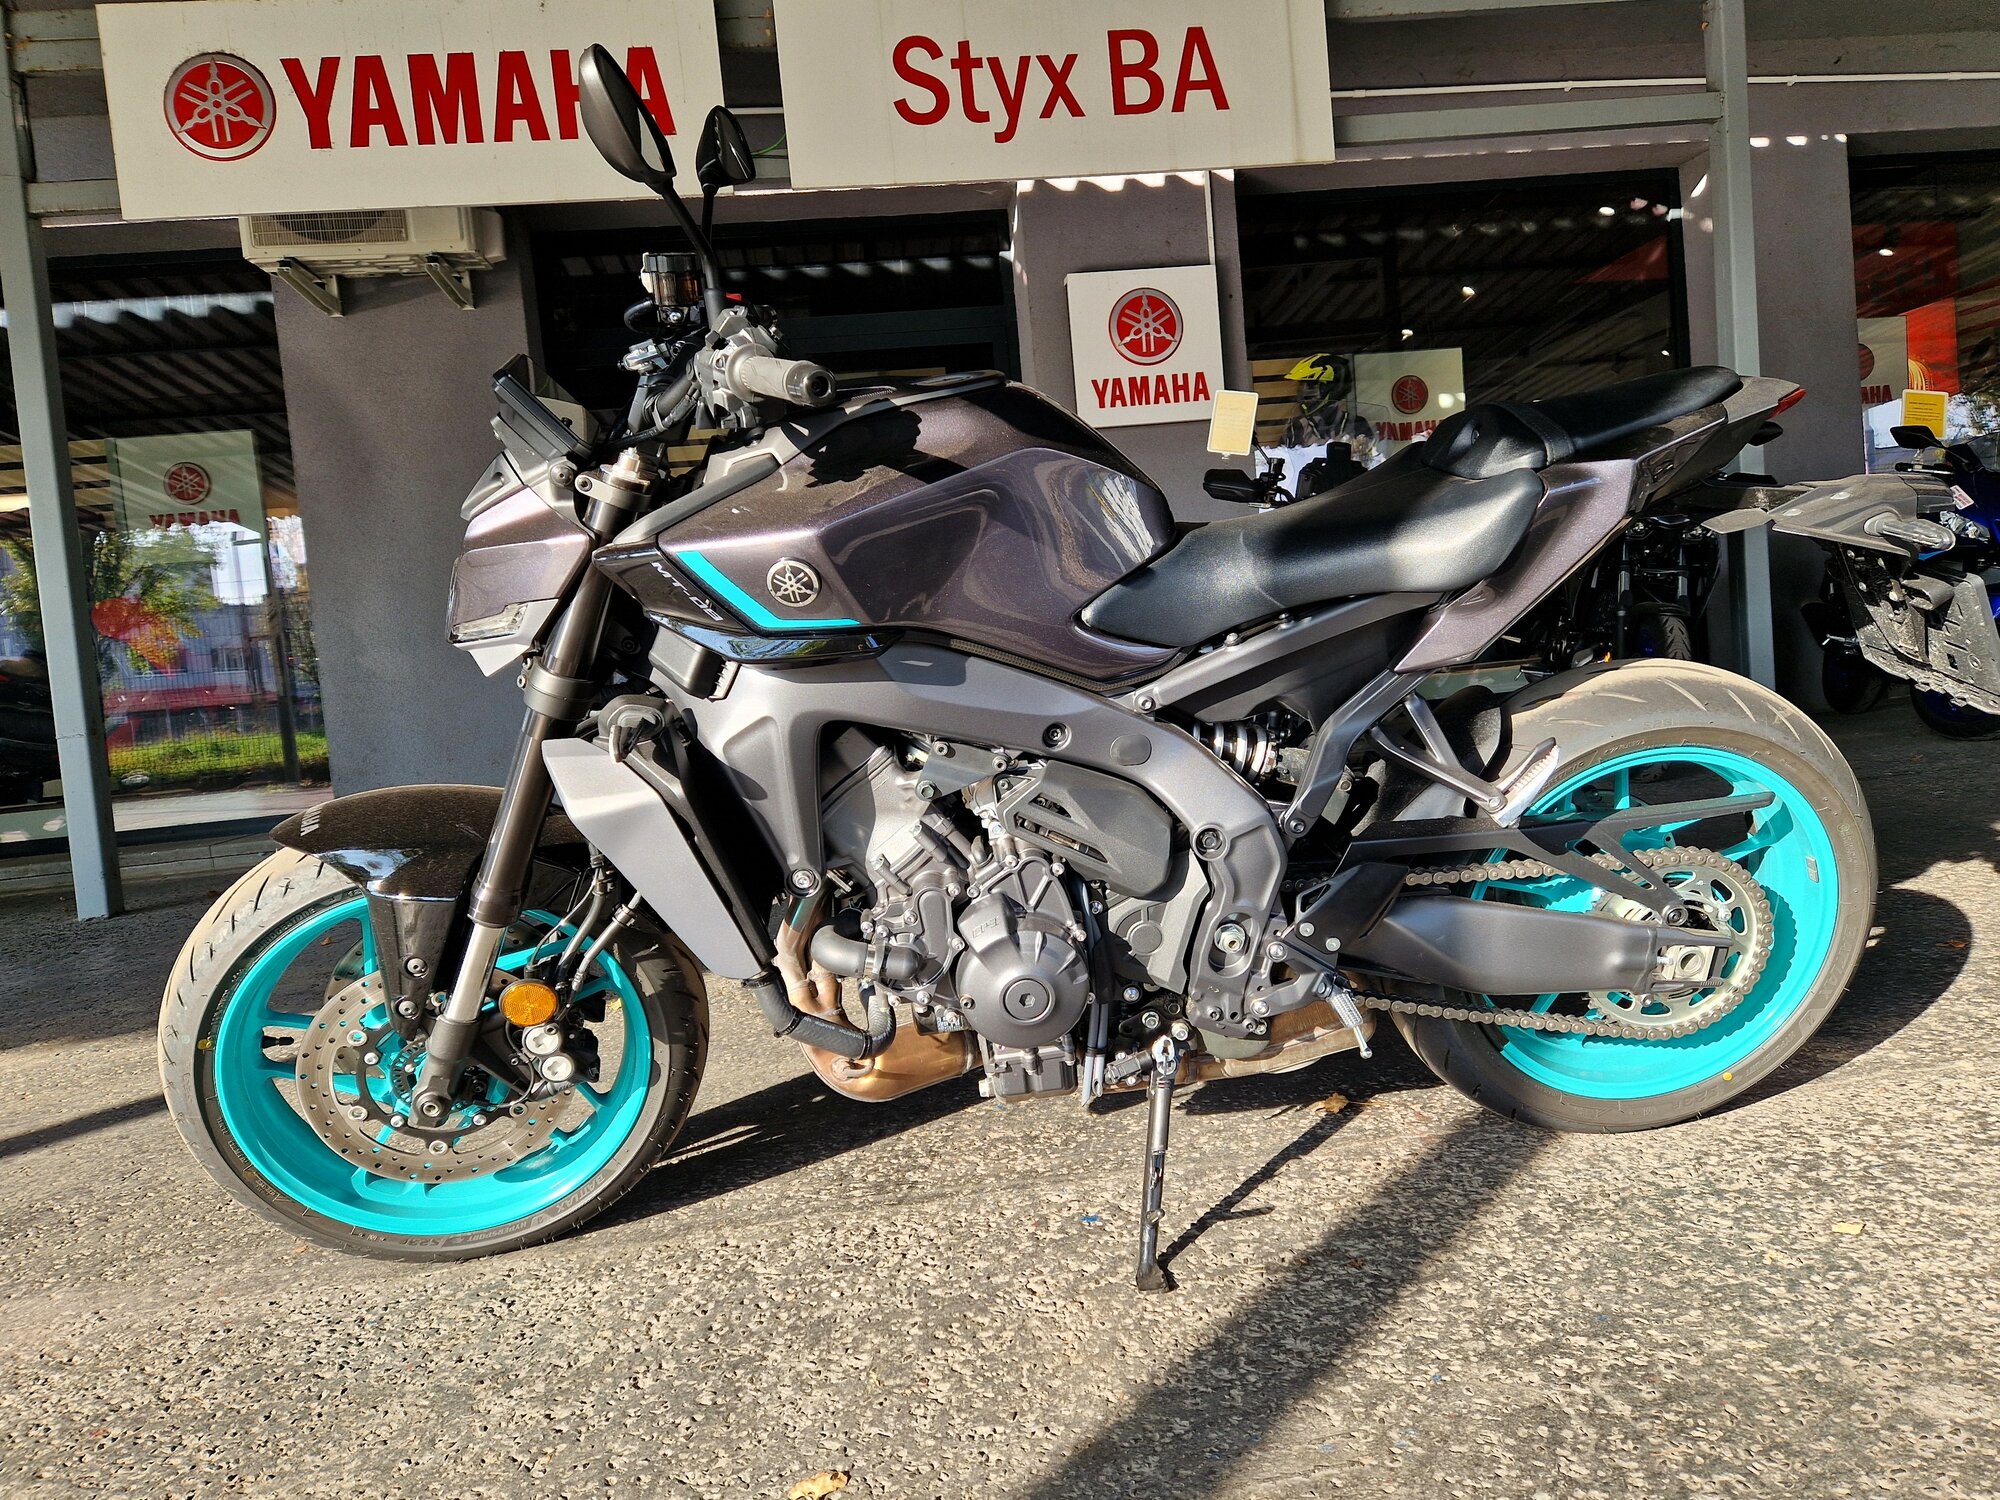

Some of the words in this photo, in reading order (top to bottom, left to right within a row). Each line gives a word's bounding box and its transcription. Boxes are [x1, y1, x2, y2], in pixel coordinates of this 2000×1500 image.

[892, 35, 1086, 144] Styx
[1107, 26, 1231, 116] BA
[1091, 371, 1211, 409] YAMAHA
[1375, 419, 1444, 441] YAMAH
[650, 562, 724, 622] MT-09
[554, 1173, 607, 1214] BATTLAX
